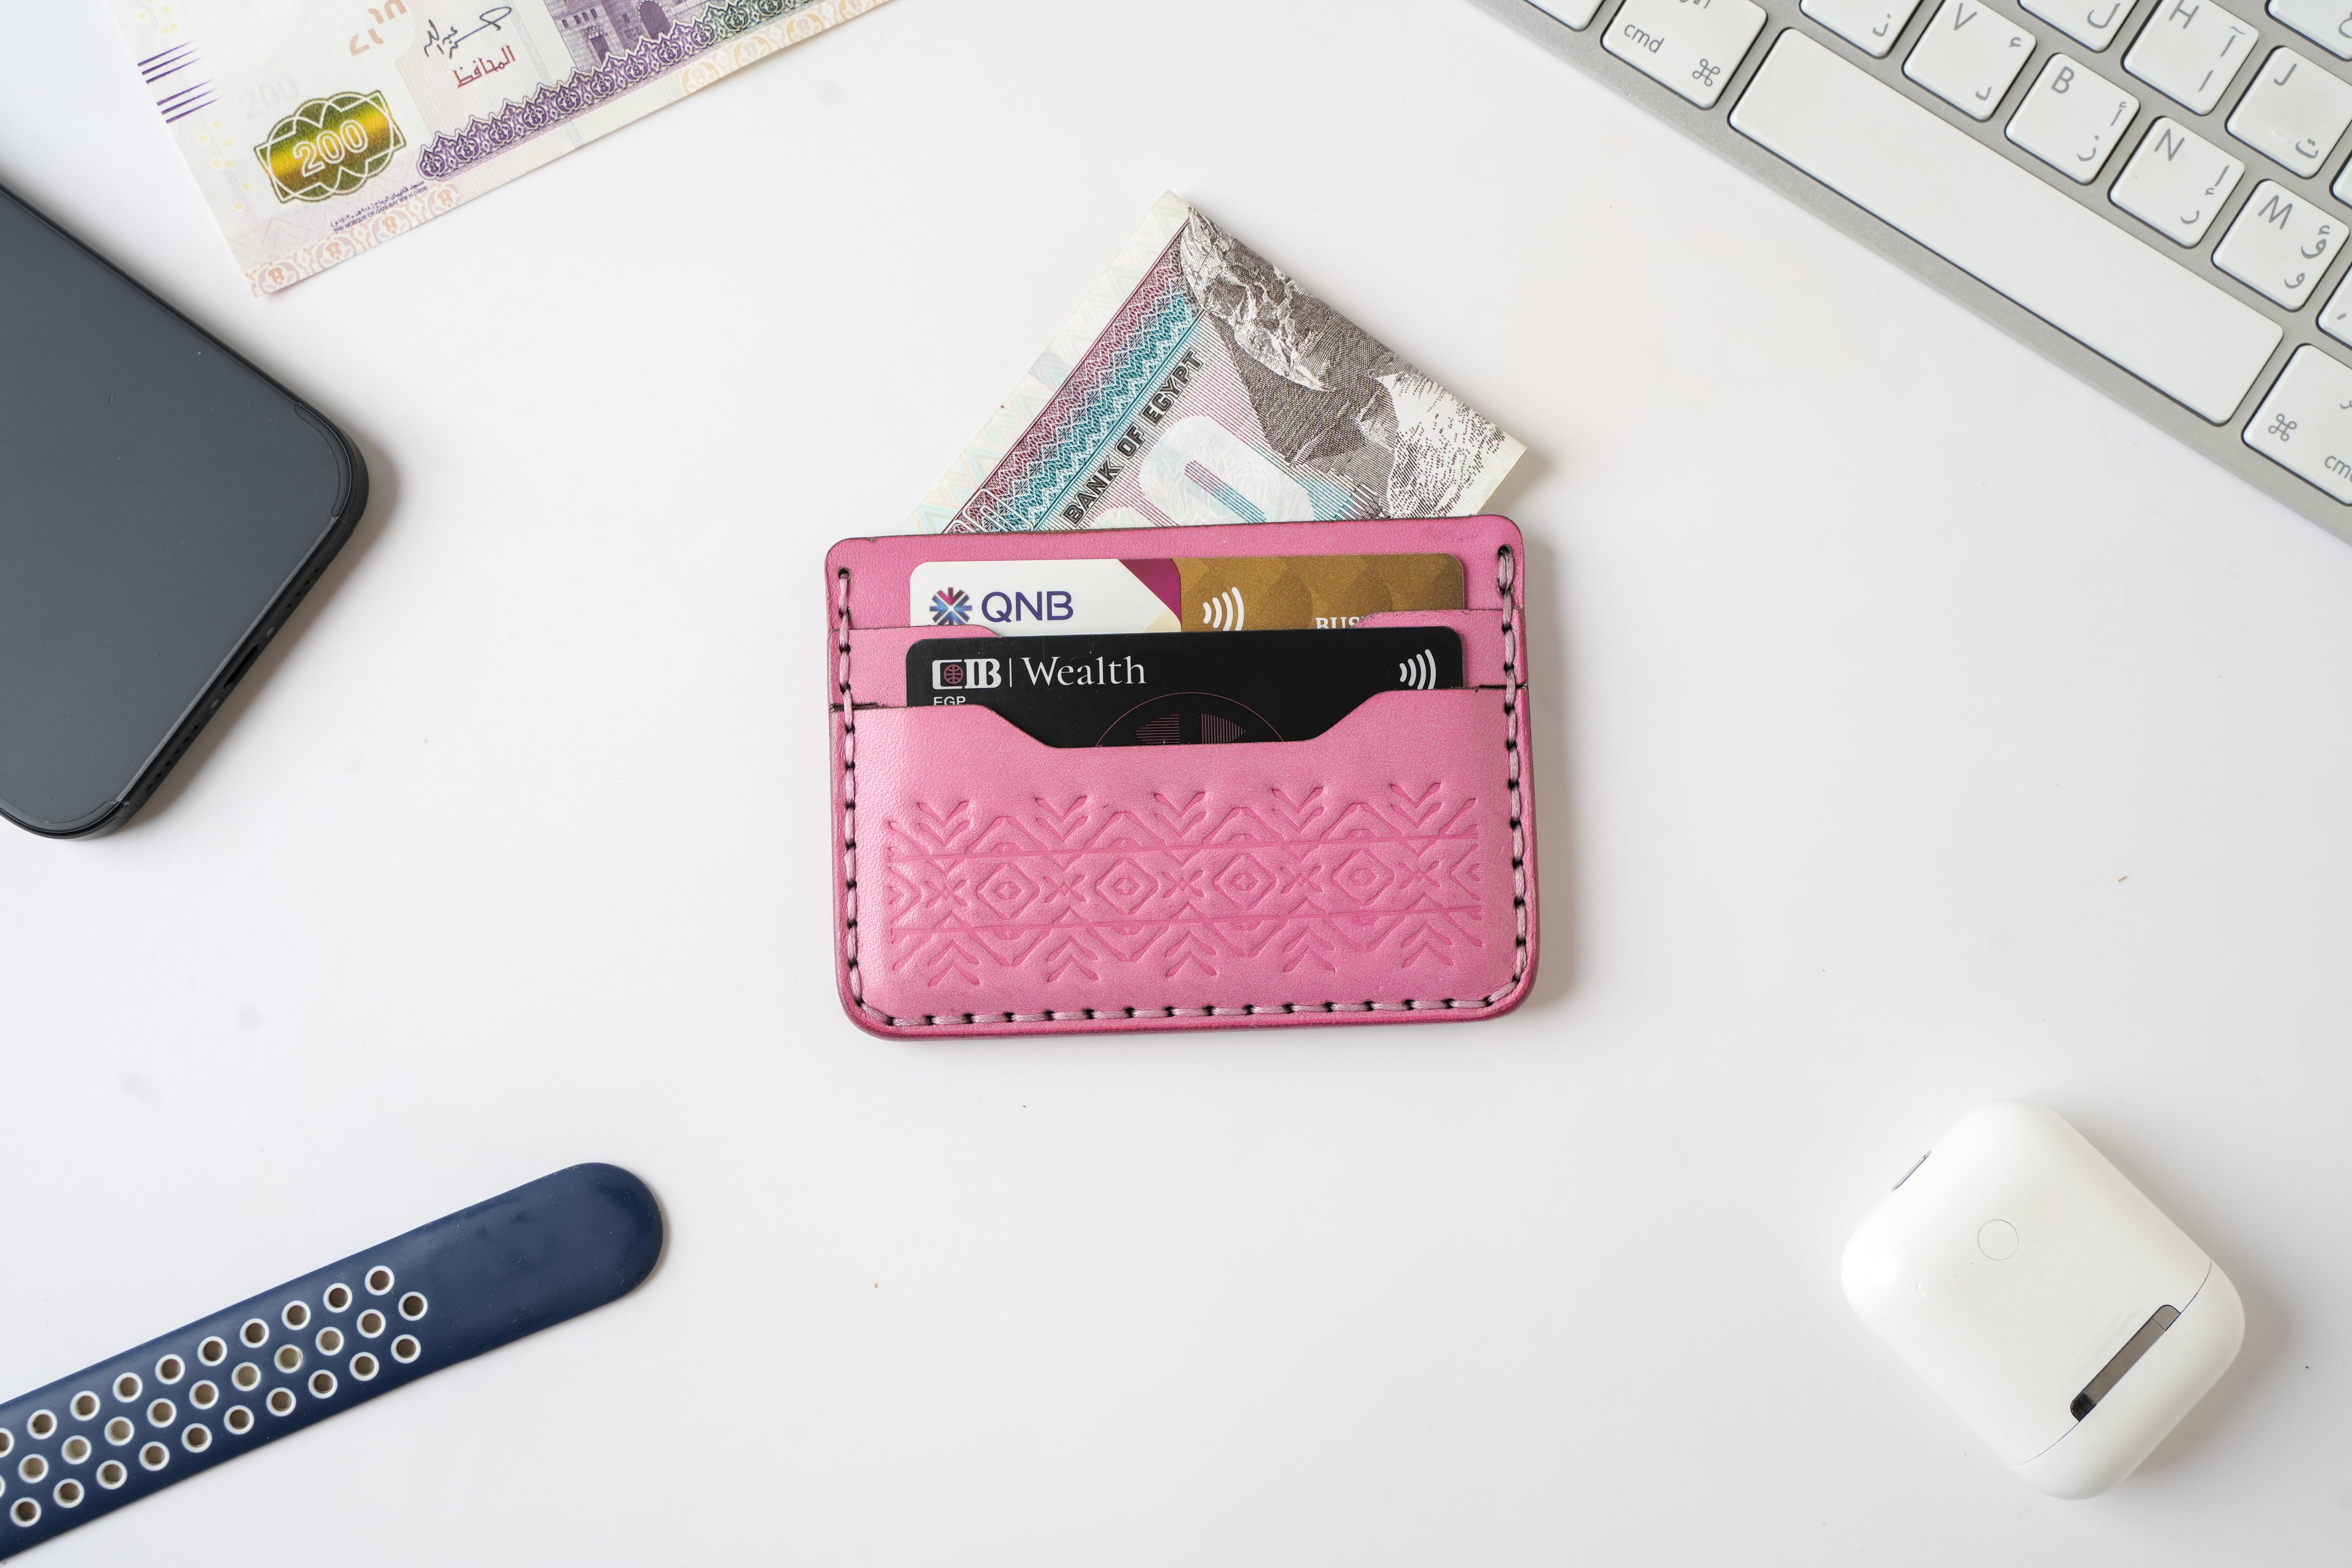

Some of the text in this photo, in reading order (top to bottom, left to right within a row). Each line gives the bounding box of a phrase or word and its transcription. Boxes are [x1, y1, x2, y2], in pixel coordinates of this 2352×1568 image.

[1954, 3, 1977, 31] V
[2169, 0, 2199, 29] H
[1624, 24, 1664, 54] cmd
[453, 45, 516, 88] المحافظ
[2051, 66, 2074, 94] B
[2274, 64, 2296, 86] J
[293, 119, 368, 177] 200
[2154, 129, 2185, 161] N
[344, 215, 367, 228] MOSQUE
[2258, 196, 2292, 230] M
[1061, 348, 1203, 527] BANK OF EGYPT
[2324, 455, 2352, 483] cm
[981, 591, 1073, 623] QNB
[932, 656, 1147, 690] CIB Wealth
